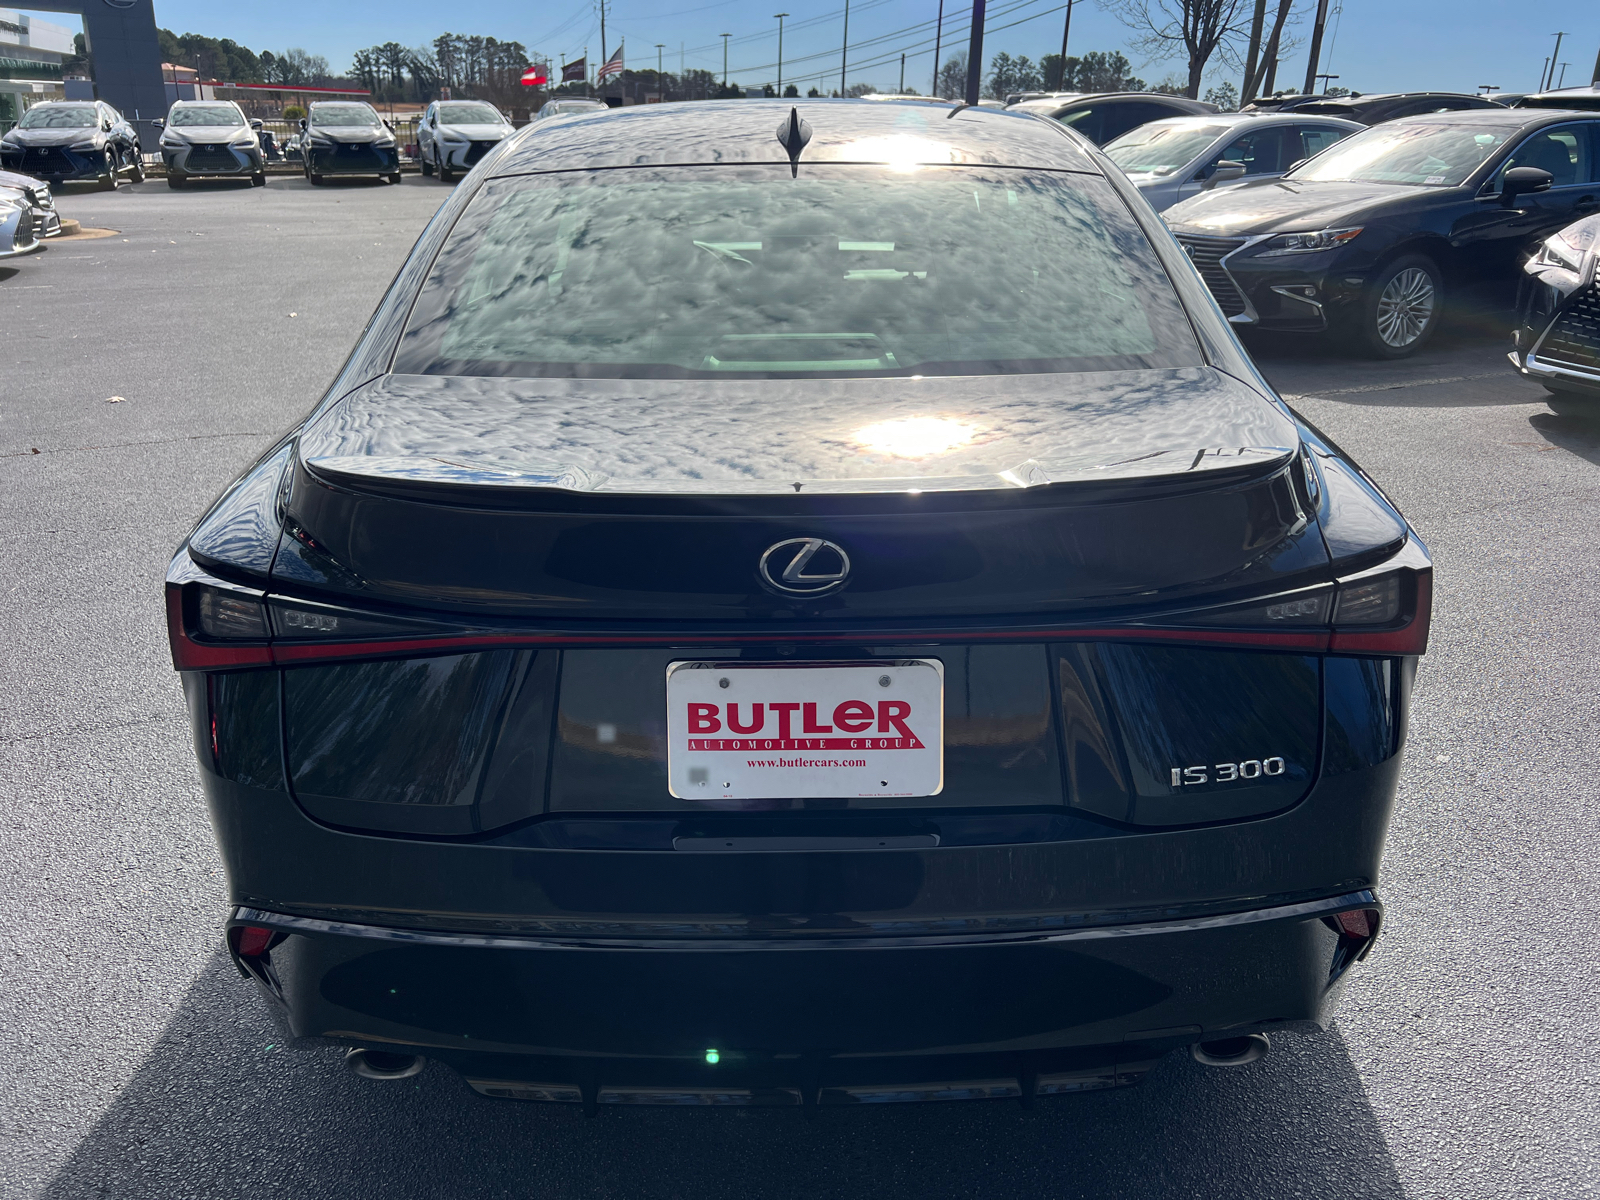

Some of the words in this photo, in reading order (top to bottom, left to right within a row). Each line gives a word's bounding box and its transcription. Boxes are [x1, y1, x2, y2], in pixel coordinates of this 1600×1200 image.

[689, 739, 827, 750] AUTOMOTIVE
[850, 738, 917, 749] GROUP
[747, 757, 867, 768] www.butlercars.com
[1171, 765, 1208, 787] IS
[1215, 756, 1286, 783] 300
